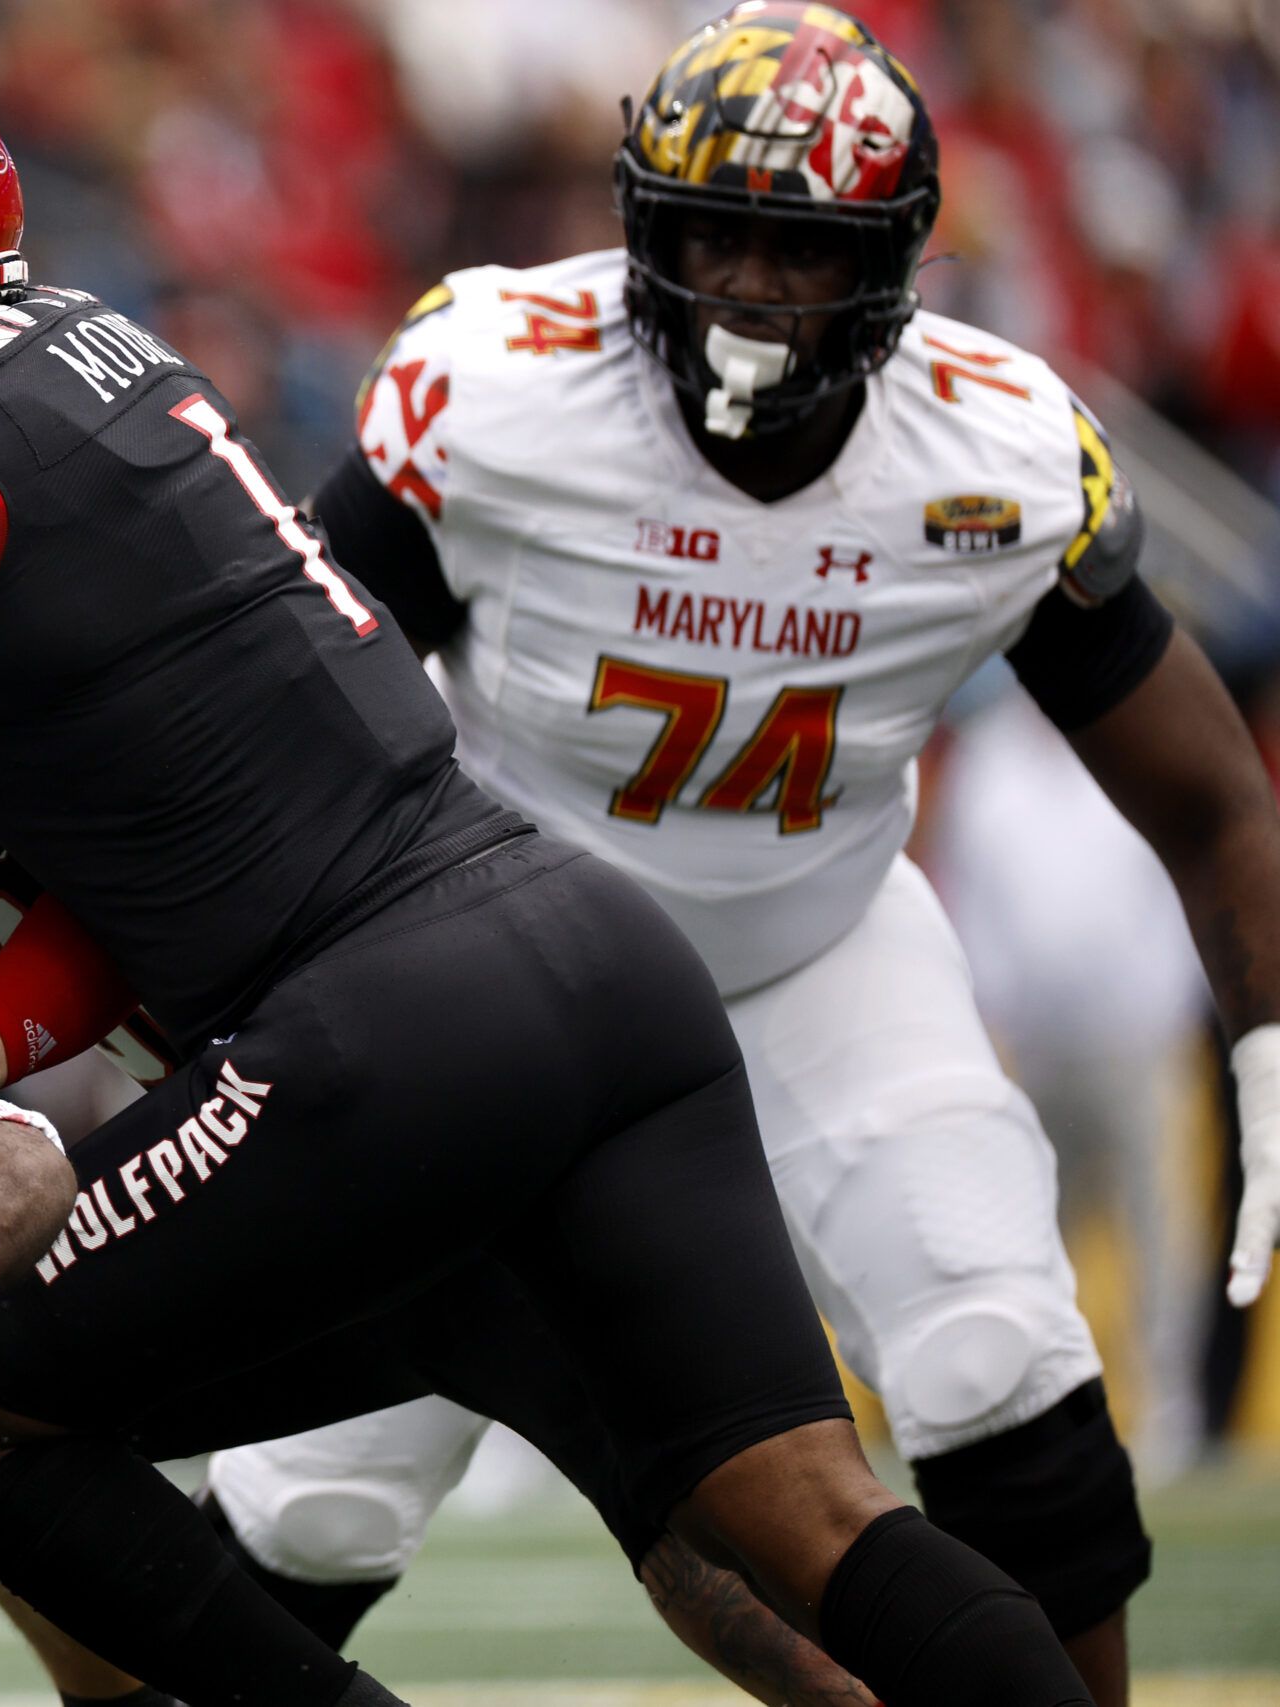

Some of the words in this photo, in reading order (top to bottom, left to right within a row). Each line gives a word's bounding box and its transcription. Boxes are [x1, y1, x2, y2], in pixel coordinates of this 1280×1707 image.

[499, 288, 602, 356] 74
[168, 393, 380, 638] 1
[634, 583, 863, 659] MARYLAND
[587, 653, 846, 836] 74
[23, 1018, 38, 1069] adida
